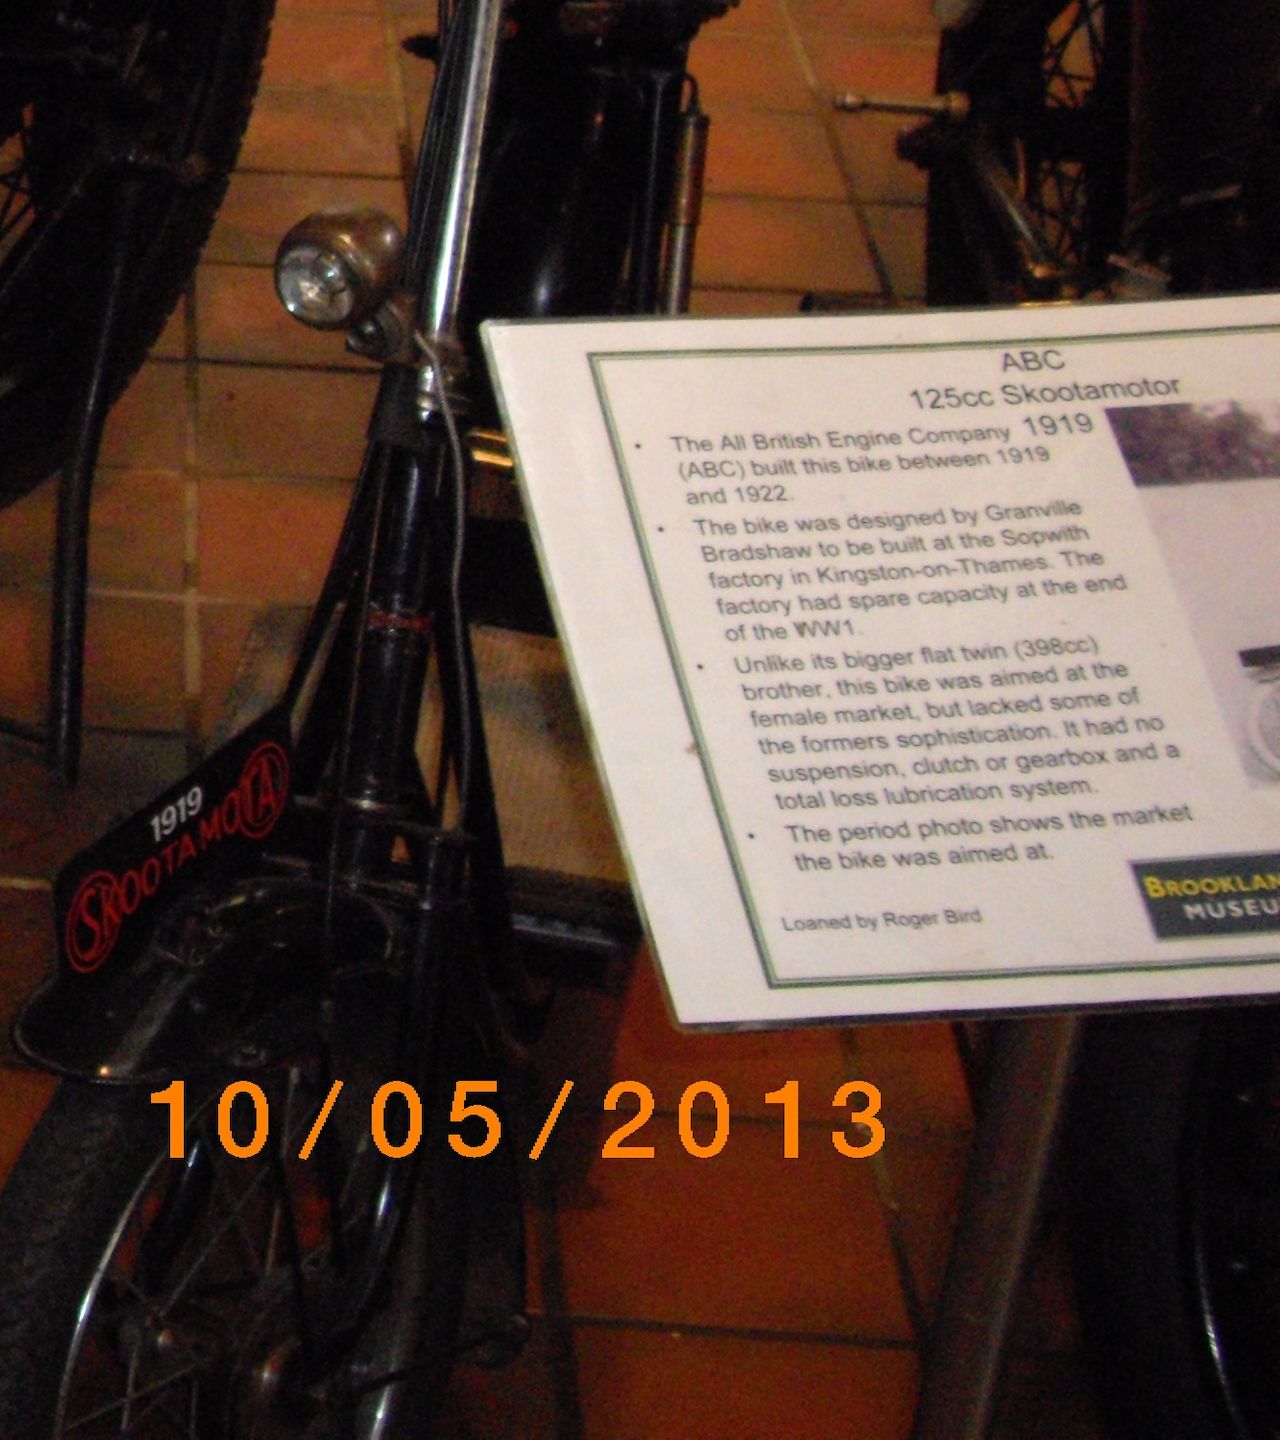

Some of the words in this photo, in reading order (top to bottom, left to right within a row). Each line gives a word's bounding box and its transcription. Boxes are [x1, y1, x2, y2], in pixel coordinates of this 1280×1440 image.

[1001, 350, 1066, 372] ABC
[909, 388, 995, 410] 125cc
[1000, 378, 1180, 405] Skootamotor
[668, 435, 715, 453] The
[719, 433, 748, 451] All
[751, 431, 822, 450] British
[824, 429, 903, 451] Engine
[906, 426, 1011, 446] Company
[1022, 413, 1094, 435] 1919
[677, 459, 747, 483] (ABC)
[749, 458, 798, 476] built
[800, 457, 843, 474] this
[845, 455, 893, 472] bike
[895, 452, 991, 470] between
[996, 445, 1051, 465] 1919
[685, 486, 728, 506] and
[734, 483, 794, 503] 1922.
[691, 518, 738, 537] The
[741, 516, 790, 535] bike
[793, 516, 842, 532] was
[846, 508, 947, 532] designed
[949, 507, 980, 527] by
[983, 499, 1083, 521] Granville
[700, 543, 813, 563] Bradshaw
[815, 541, 841, 557] to
[844, 539, 876, 556] be
[878, 535, 928, 554] built
[931, 533, 956, 550] at
[956, 532, 996, 549] the
[999, 524, 1091, 548] Sopwith
[149, 786, 203, 842] 1919
[785, 825, 833, 844] The
[837, 820, 912, 846] period
[916, 817, 985, 842] photo
[988, 815, 1065, 833] shows
[1066, 810, 1108, 829] the
[1111, 804, 1195, 826] market
[792, 853, 833, 872] the
[836, 850, 888, 870] bike
[891, 850, 943, 867] was
[946, 842, 1020, 864] aimed
[1023, 842, 1054, 859] at.
[780, 914, 853, 932] Loaned
[853, 913, 879, 932] by
[881, 911, 940, 930] Roger
[942, 906, 984, 924] Bird
